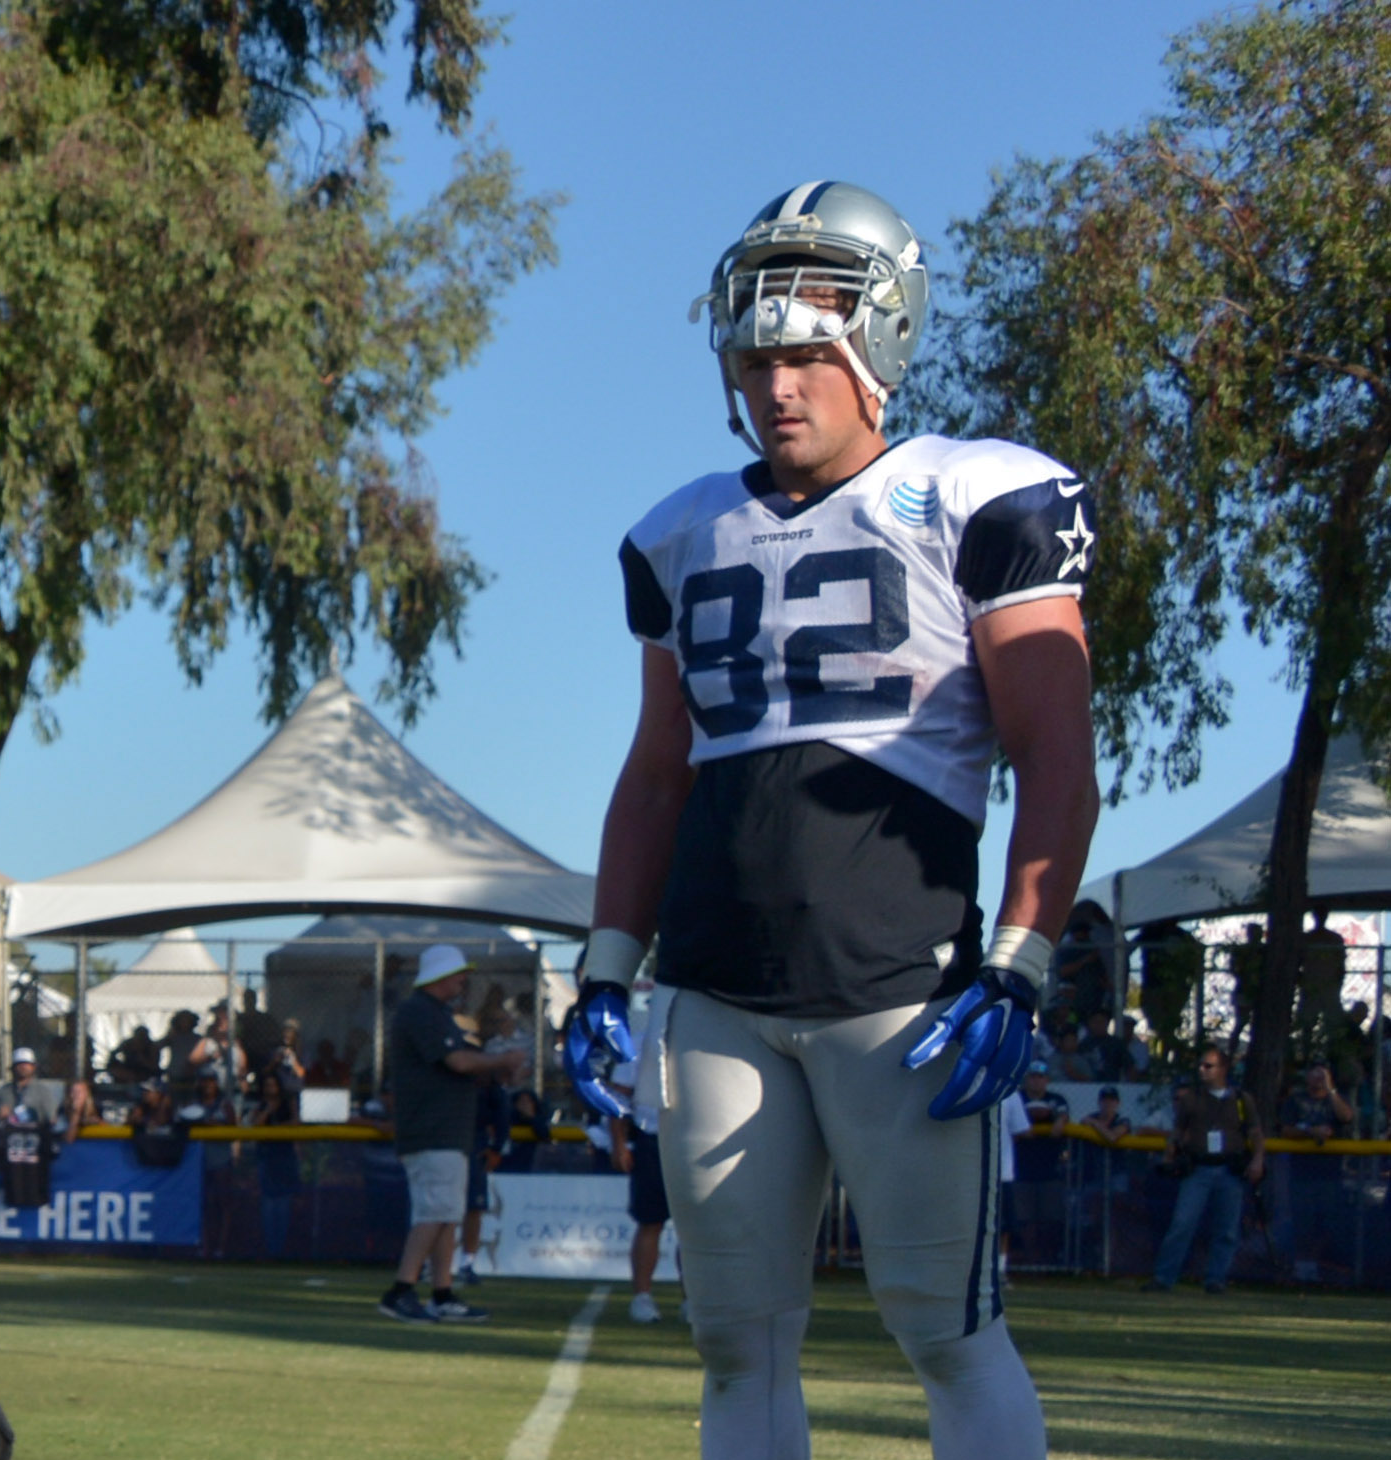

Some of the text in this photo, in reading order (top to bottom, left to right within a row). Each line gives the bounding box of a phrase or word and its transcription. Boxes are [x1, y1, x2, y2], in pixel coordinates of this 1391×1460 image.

[751, 528, 814, 546] COWBOYS
[677, 546, 913, 739] 82
[38, 1190, 154, 1241] HERE
[516, 1221, 630, 1242] GAYLOR
